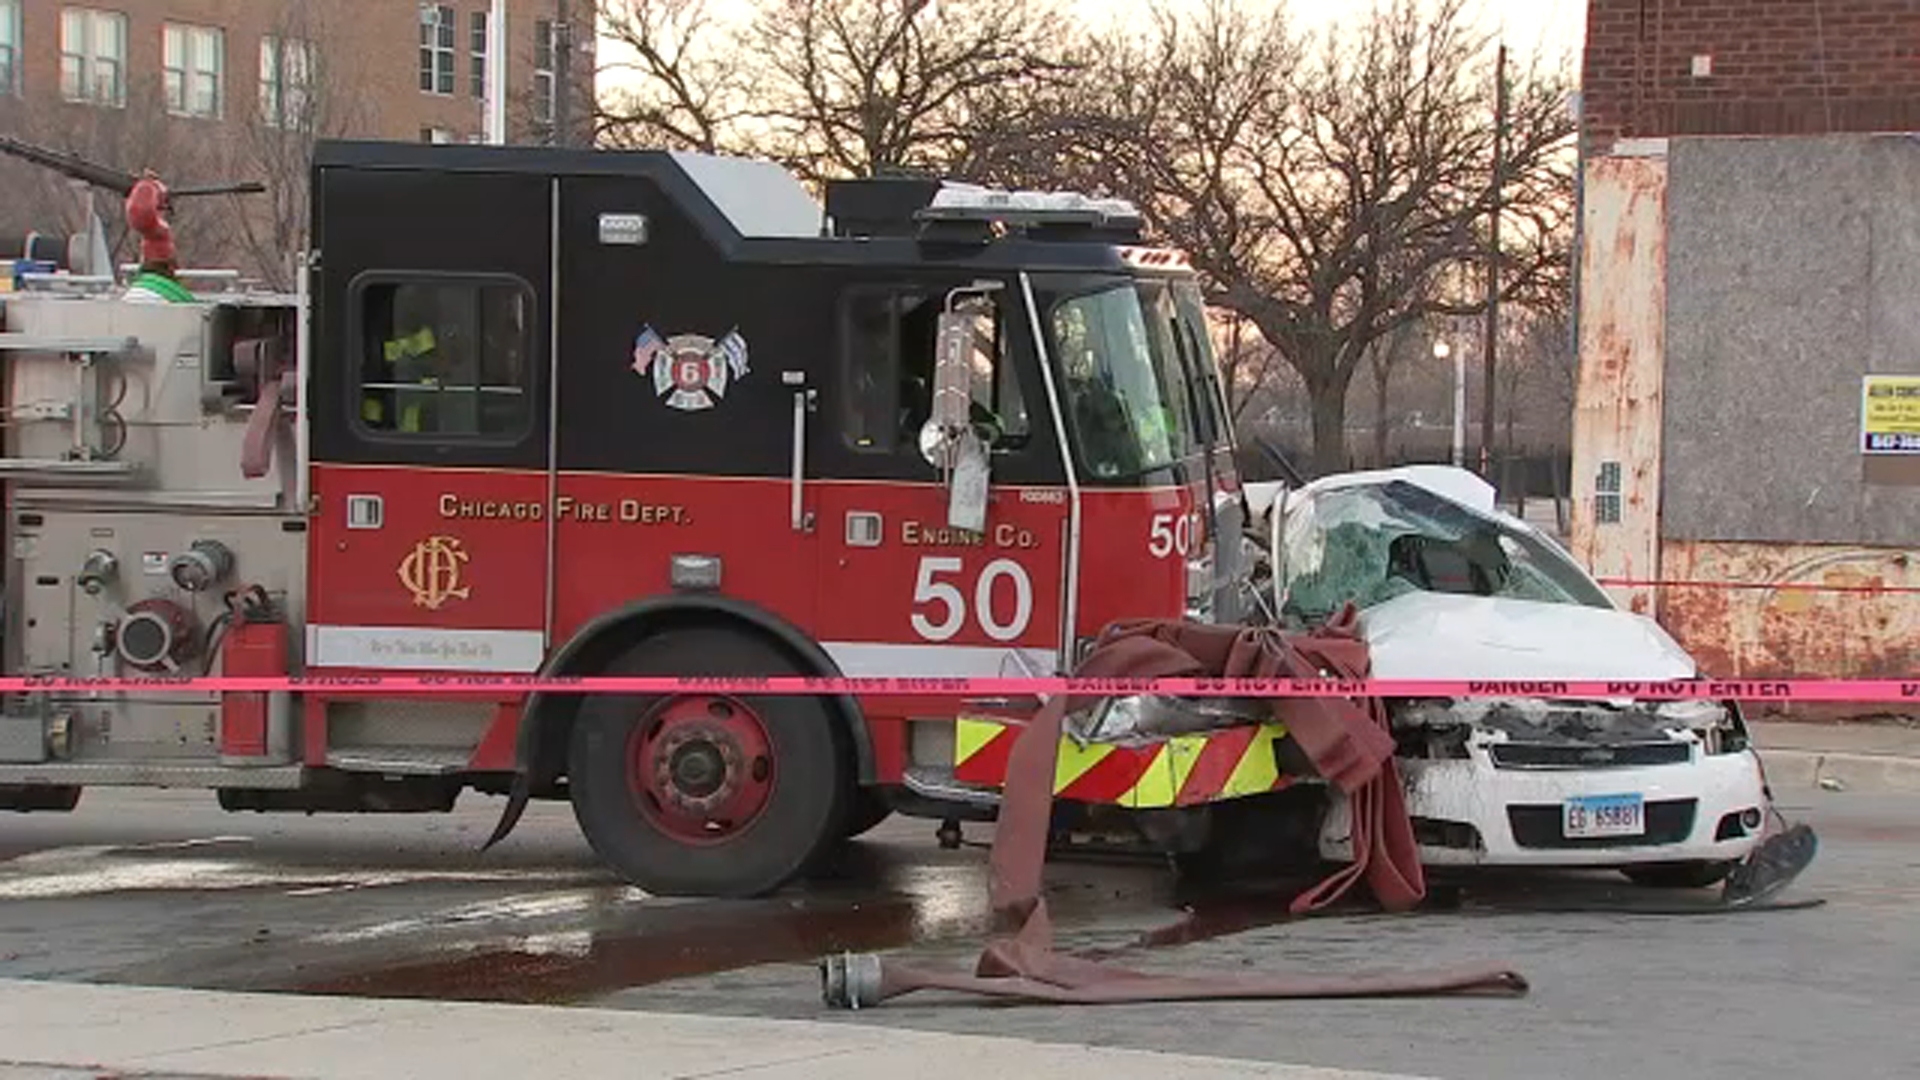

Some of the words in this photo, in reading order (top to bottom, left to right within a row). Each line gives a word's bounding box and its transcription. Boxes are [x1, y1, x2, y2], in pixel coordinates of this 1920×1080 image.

[681, 362, 700, 384] 6
[439, 494, 543, 520] CHICAGO
[556, 497, 609, 520] FIRE
[1148, 514, 1189, 558] 50
[910, 556, 1033, 641] 50
